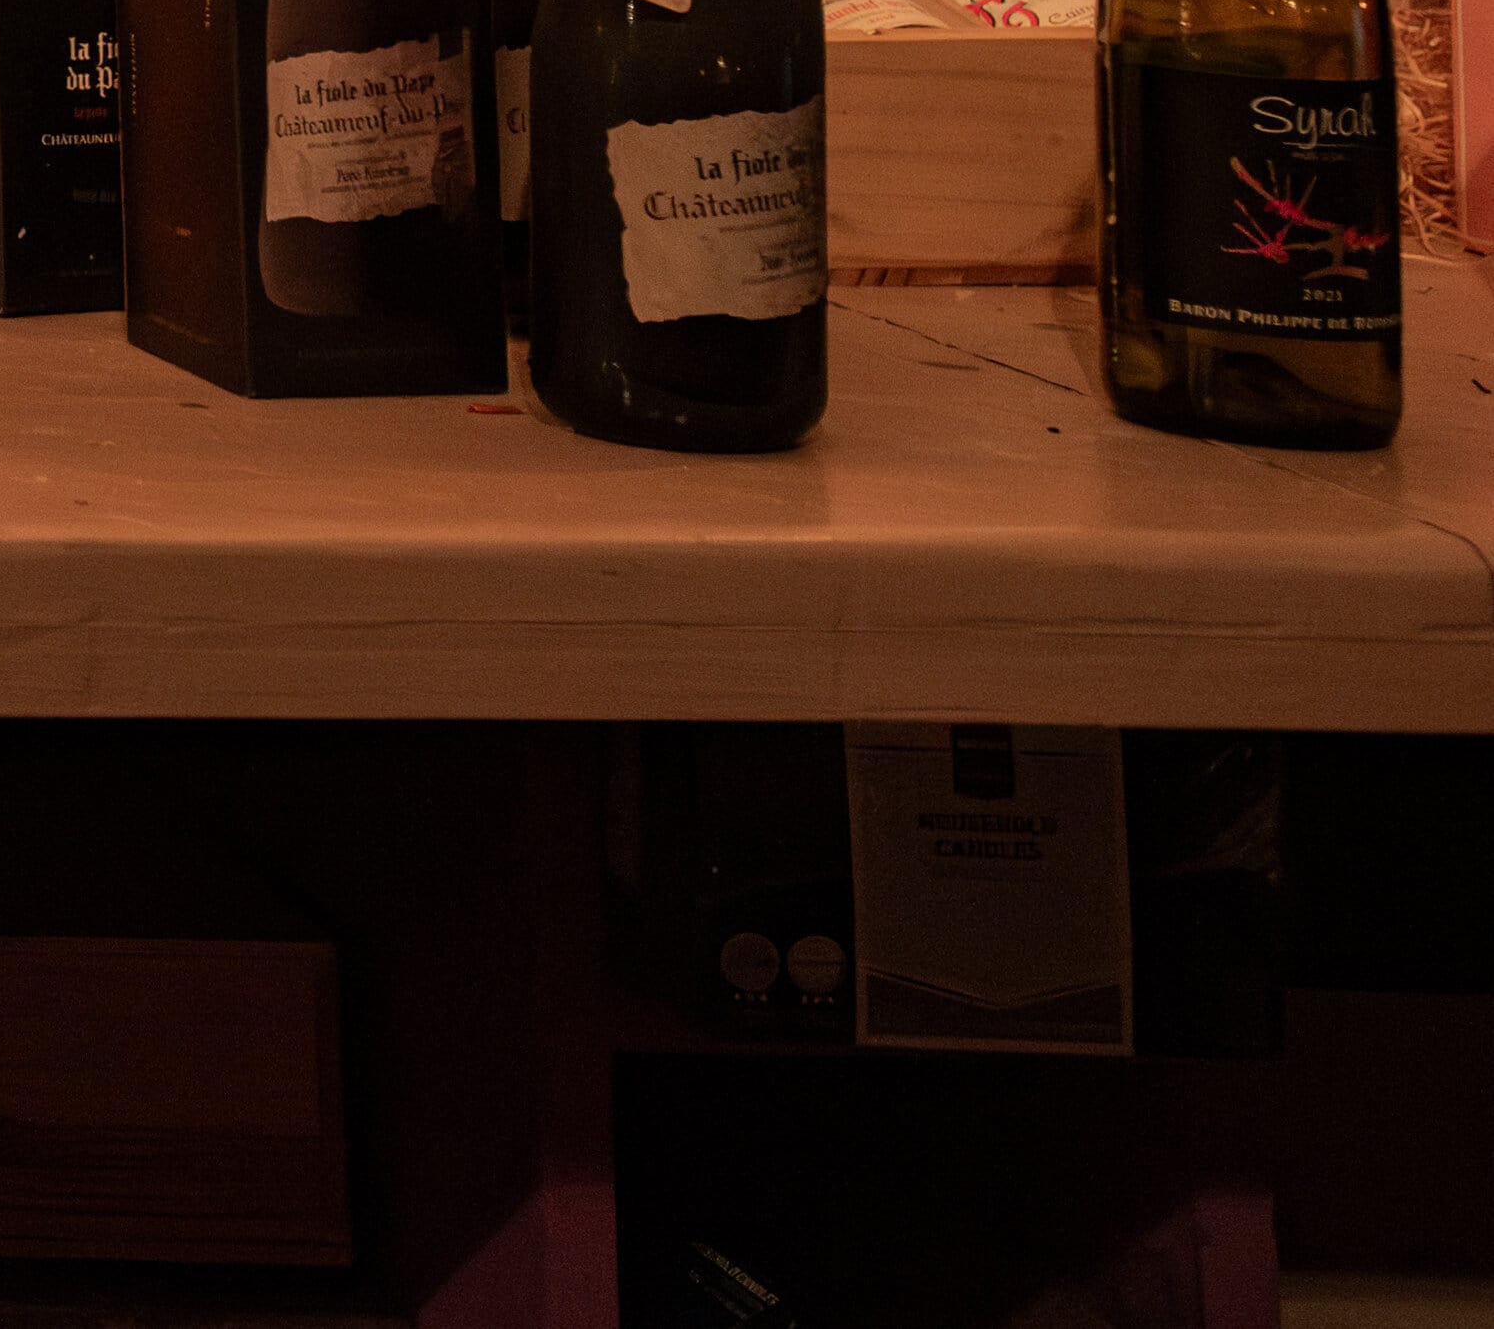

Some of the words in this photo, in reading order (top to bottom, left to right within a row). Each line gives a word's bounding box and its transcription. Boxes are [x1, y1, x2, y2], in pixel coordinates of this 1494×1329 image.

[68, 35, 91, 62] la
[65, 65, 94, 92] du
[294, 84, 312, 105] la
[316, 79, 358, 109] fiole
[1249, 92, 1377, 150] Syrah
[694, 155, 722, 181] la
[1167, 297, 1233, 321] BARON
[1235, 306, 1322, 330] PHILIPPE
